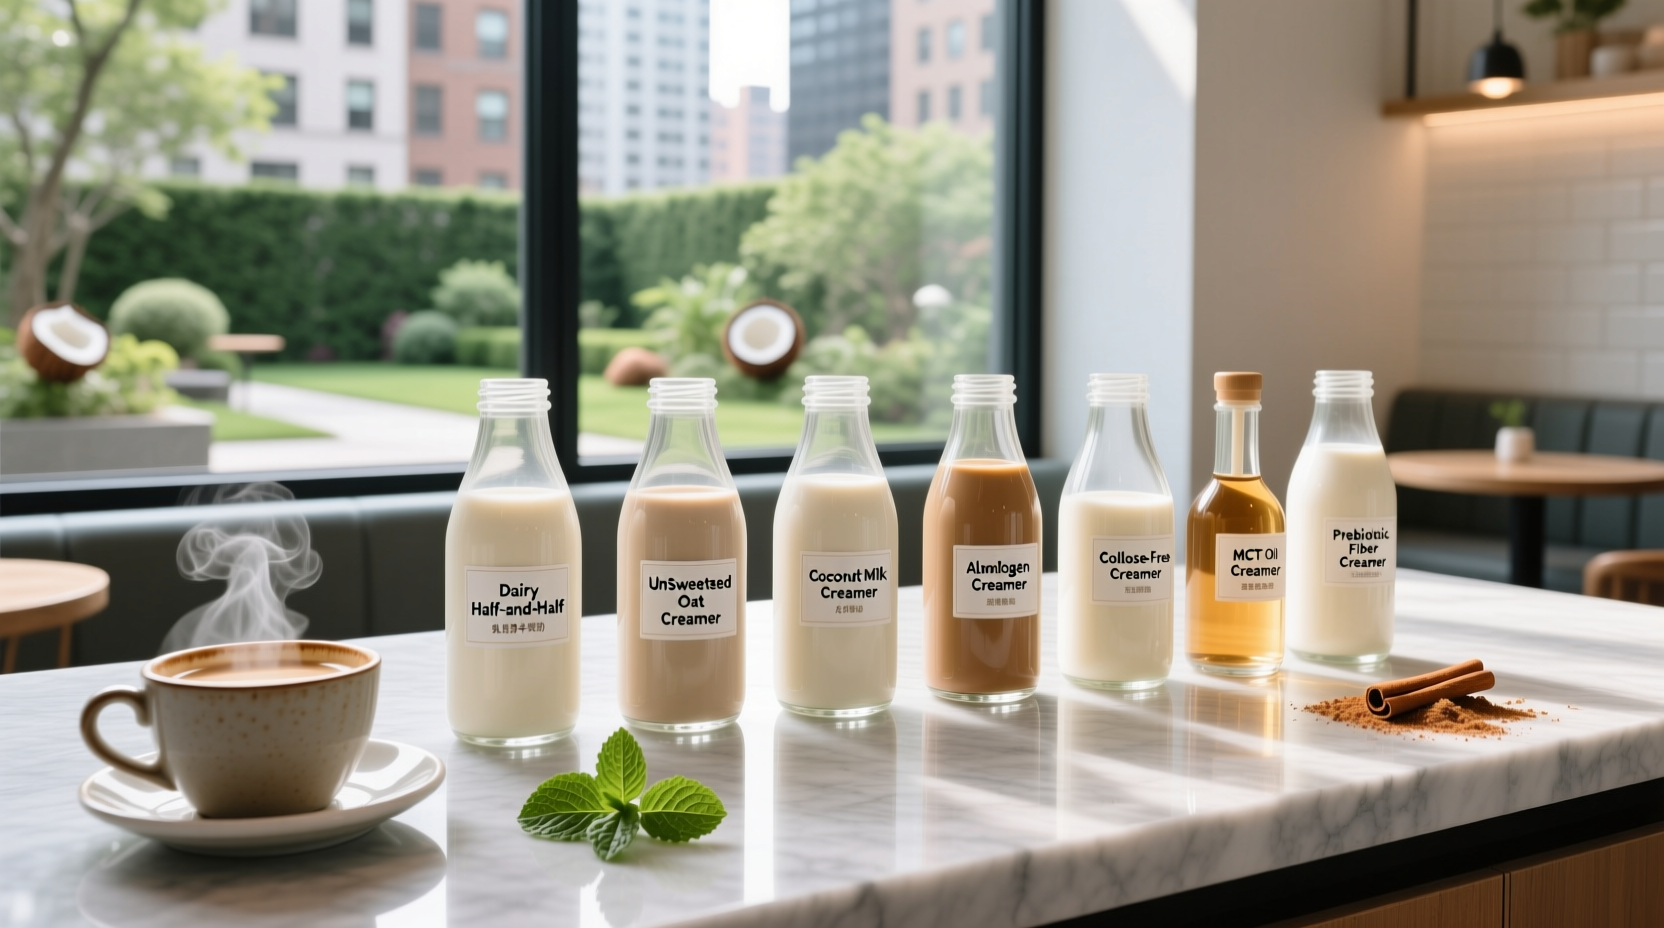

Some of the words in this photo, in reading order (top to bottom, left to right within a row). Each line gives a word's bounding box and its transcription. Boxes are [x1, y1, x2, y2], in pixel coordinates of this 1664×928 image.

[1233, 548, 1263, 561] MCT
[1340, 556, 1387, 568] Creamer
[1110, 567, 1162, 580] Creamer
[1231, 564, 1281, 577] Creamer
[972, 578, 1027, 591] Creamer
[500, 583, 539, 601] Dairy
[821, 586, 878, 599] Creamer
[472, 599, 565, 616] Half-and-Half
[678, 594, 705, 608] Oat
[661, 612, 721, 625] Creamer
